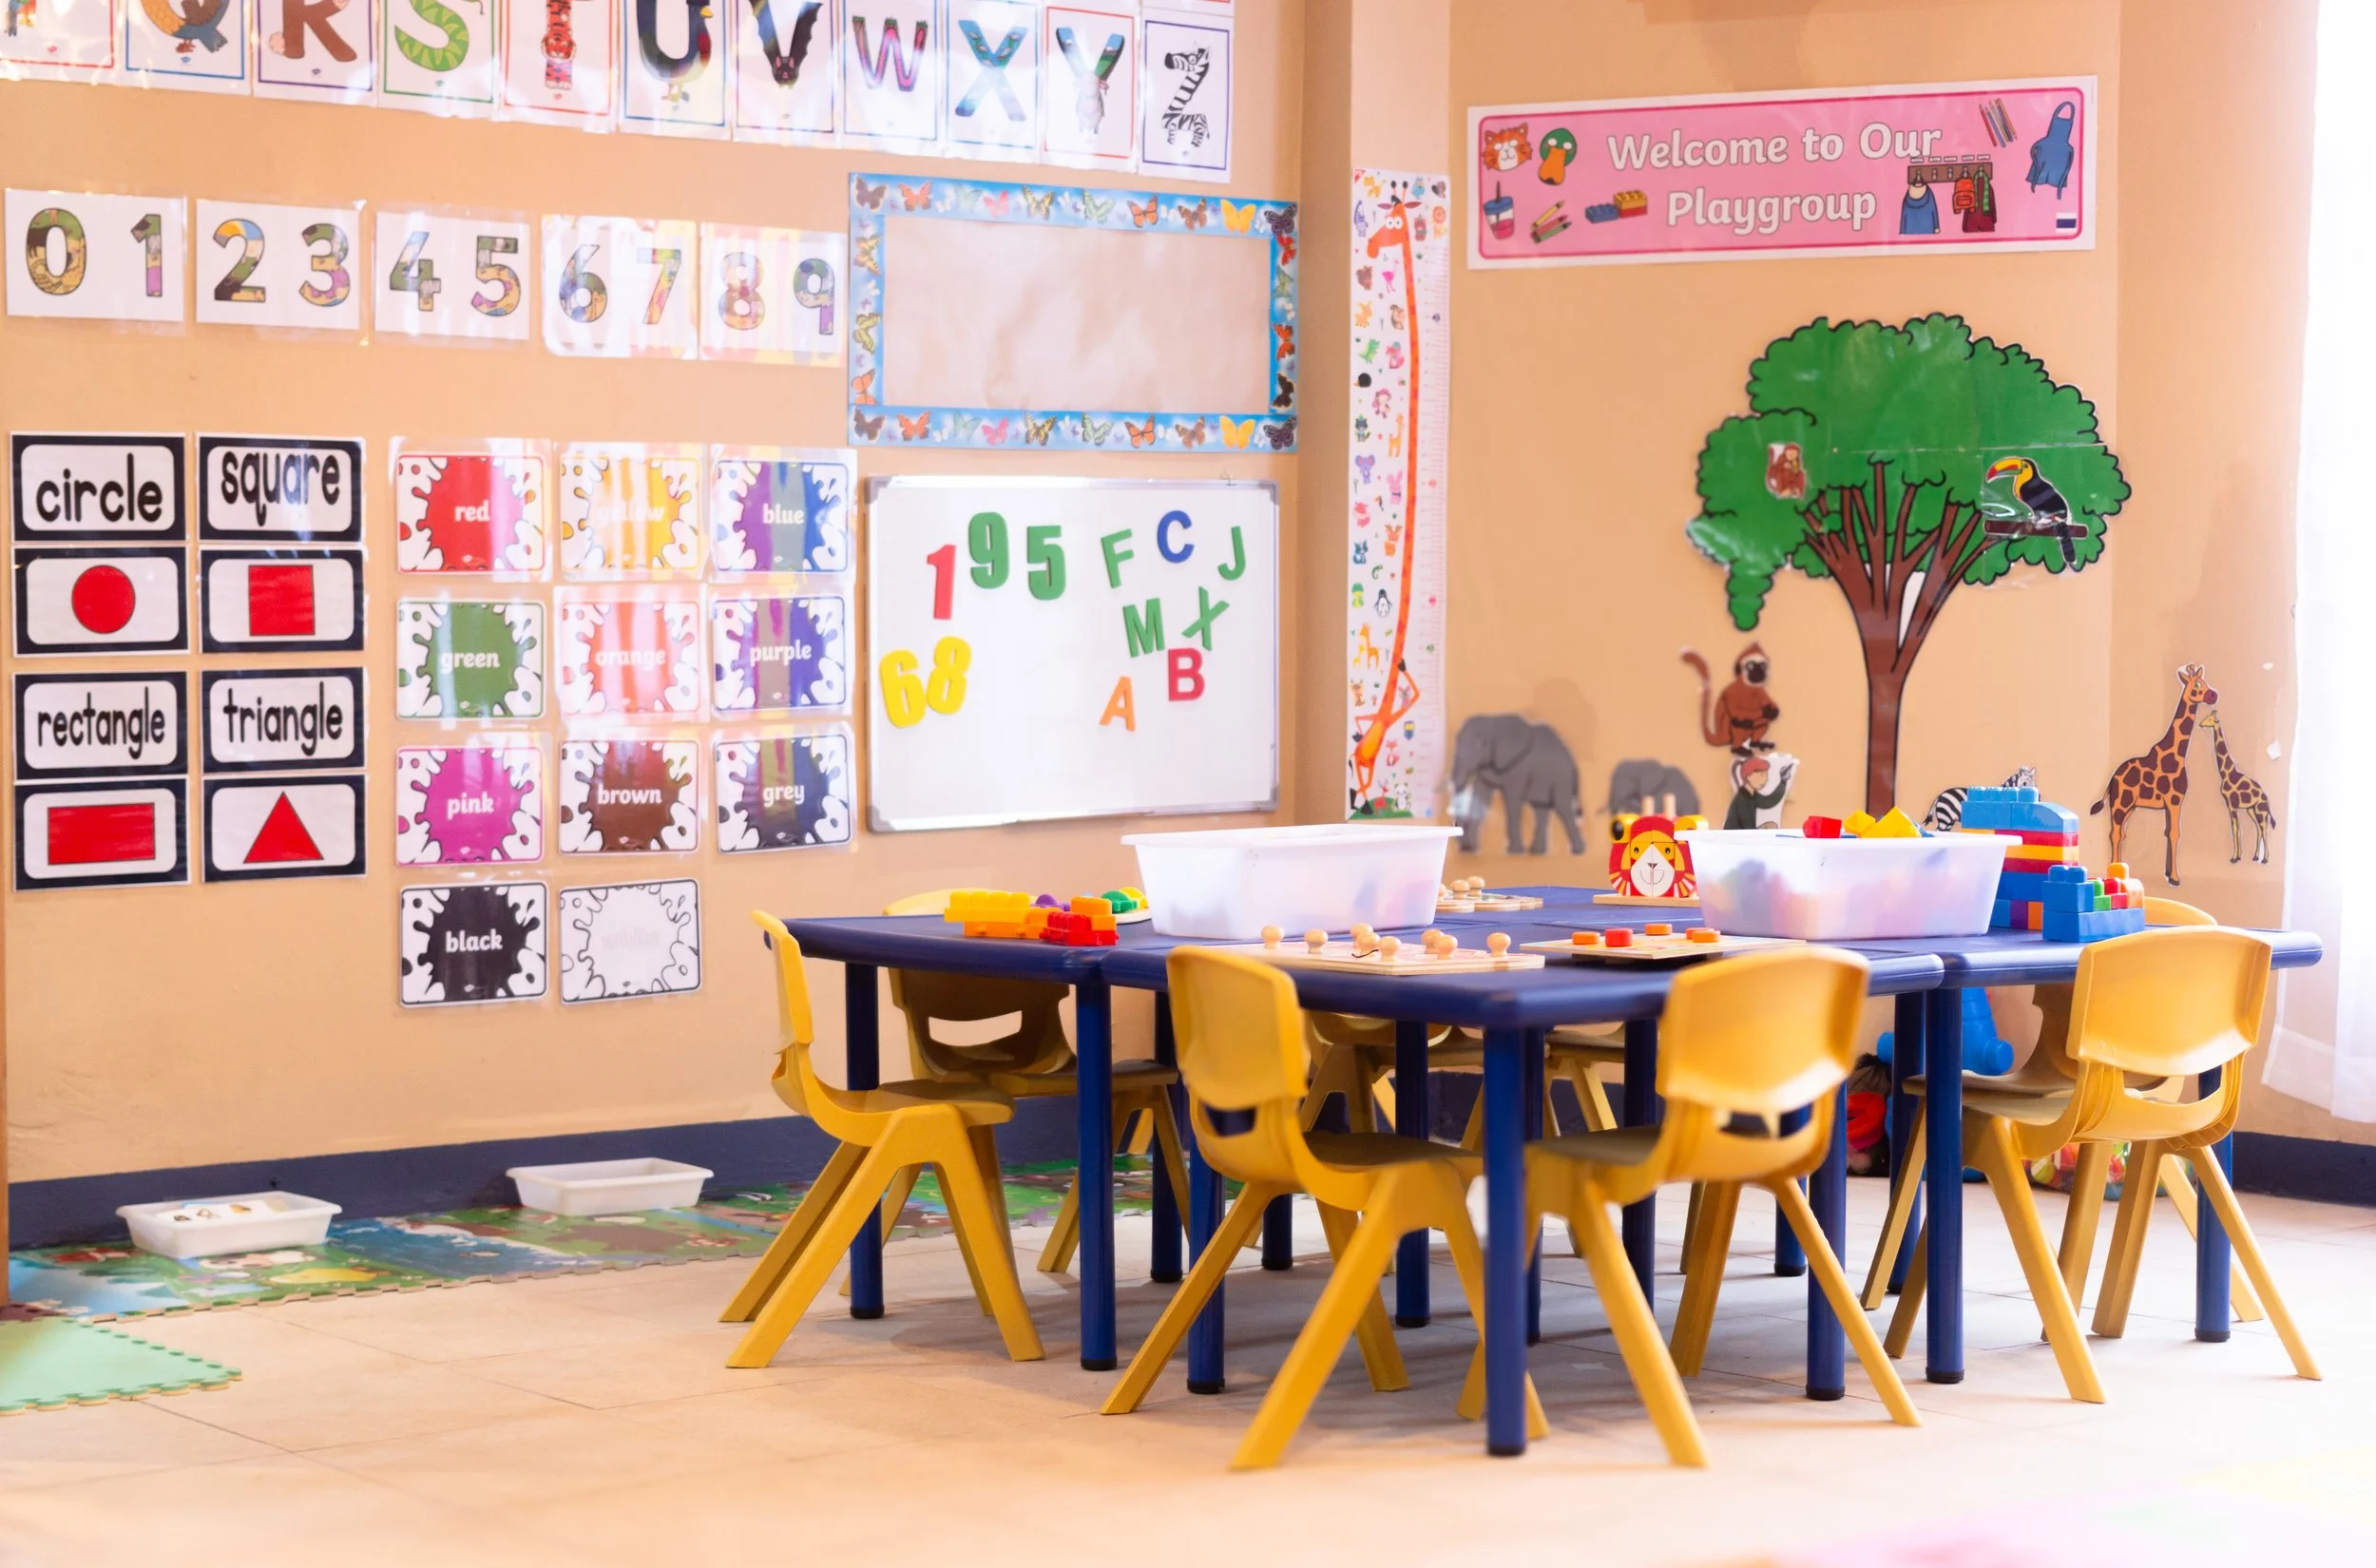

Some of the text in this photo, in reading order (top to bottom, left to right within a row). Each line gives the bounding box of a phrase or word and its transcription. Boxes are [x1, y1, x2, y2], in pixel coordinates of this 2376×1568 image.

[394, 0, 469, 71] S
[636, 0, 714, 99] U
[749, 0, 823, 87] V
[852, 15, 929, 92] W
[954, 19, 1029, 122] X
[1056, 27, 1125, 136] Y
[1161, 41, 1211, 147] Z
[1606, 120, 1943, 170] Welcome to Our
[1666, 185, 1877, 234] Playgroup
[26, 207, 163, 296] 0 1
[213, 219, 351, 307] 2 3
[389, 231, 520, 316] 4 5
[558, 244, 681, 325] 6 7
[718, 251, 835, 335] 8 9
[36, 453, 163, 522] circle
[221, 451, 340, 526] square
[454, 503, 490, 523] red
[762, 503, 805, 526] blue
[1101, 510, 1247, 588] F C J
[750, 643, 812, 669] purple
[1122, 585, 1230, 658] M X
[440, 648, 500, 672] green
[595, 648, 666, 672] orange
[1168, 647, 1205, 701] B
[37, 686, 165, 759] rectangle
[222, 681, 343, 755] triangle
[1099, 676, 1136, 732] A
[447, 793, 494, 817] pink
[597, 785, 662, 805] brown
[762, 783, 805, 811] grey
[445, 927, 504, 952] black
